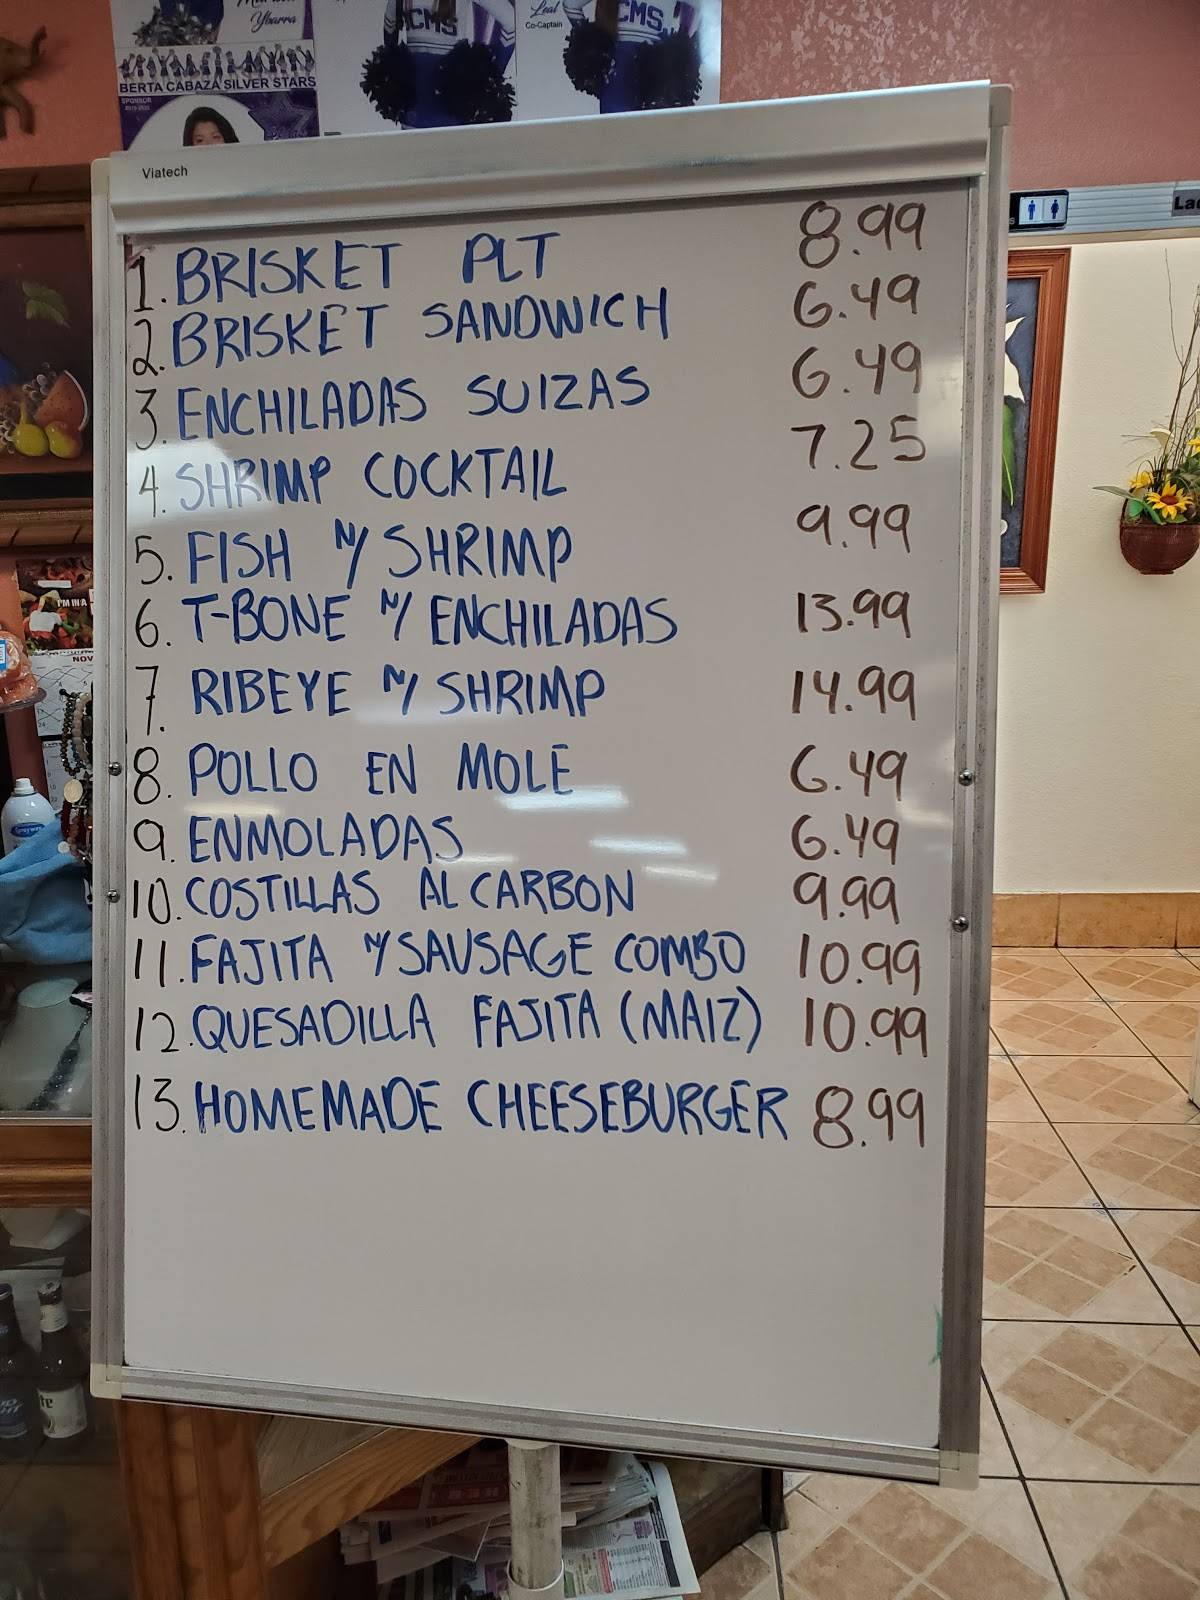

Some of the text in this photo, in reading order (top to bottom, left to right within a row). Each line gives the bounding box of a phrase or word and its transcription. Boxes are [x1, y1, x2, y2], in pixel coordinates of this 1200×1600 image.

[250, 10, 297, 33] Ybarra
[525, 21, 563, 29] Co-Captain
[618, 0, 664, 31] CMS
[120, 76, 317, 94] BERTA CABAZA SILVER STARS
[142, 165, 188, 180] Viatech
[131, 200, 927, 312] 1. BRISKET PLT 8.99
[132, 273, 920, 377] 2. BRISKET SANDWICH 6.49
[135, 341, 922, 451] 3. ENCHILADAS SUIZAS 6.49
[138, 414, 927, 518] 4. SHRIMP COCKTAIL 7.25
[135, 535, 173, 585] 5.
[187, 528, 292, 585] FISH
[383, 522, 573, 583] SHRIMP
[796, 503, 911, 553] 9.99
[81, 598, 88, 607] A
[135, 598, 172, 648] 6.
[181, 587, 351, 645] T-BONE
[430, 593, 679, 648] ENCHILADAS
[797, 588, 912, 639] 13.99
[135, 665, 166, 736] 7.
[191, 667, 353, 717] RIBEYE
[436, 665, 606, 717] SHRIMP
[791, 665, 916, 721] 14.99
[133, 742, 908, 805] 8. POLLO EN MOLE 6.49
[133, 812, 900, 865] 9. ENMOLADAS 6.49
[132, 866, 900, 925] 10. COSTILLAS AL CARBON 9.99
[134, 937, 185, 988] 11.
[191, 932, 334, 985] FAJITA
[398, 928, 593, 977] SAUSAGE
[614, 929, 747, 982] COMBO
[799, 933, 922, 996] 10.99
[136, 985, 928, 1058] 12. QUESADILLA FAJITA (MAIZ) 10.99
[135, 1073, 926, 1149] 13. HOMEMADE CHEESEBURGER 8.99
